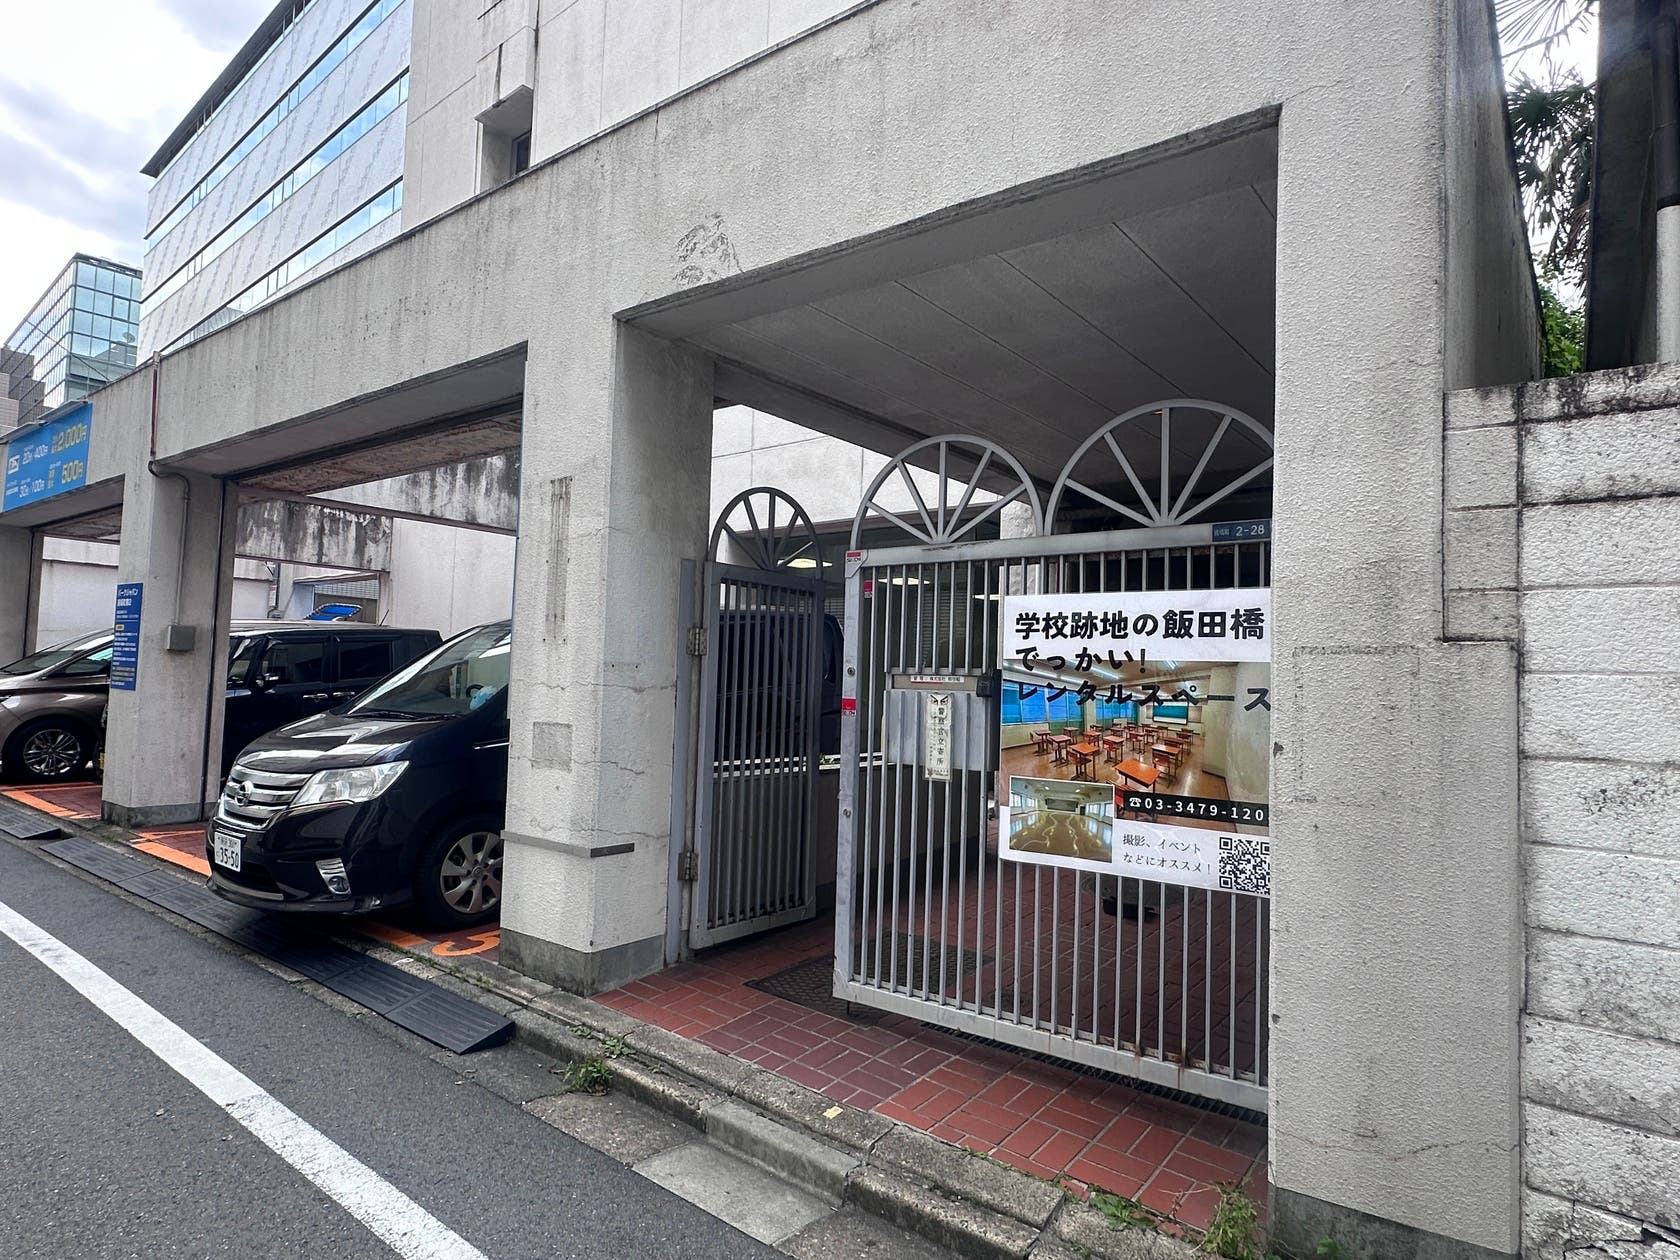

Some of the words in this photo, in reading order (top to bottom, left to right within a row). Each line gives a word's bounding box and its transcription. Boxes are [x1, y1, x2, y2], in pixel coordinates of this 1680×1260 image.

[1235, 524, 1265, 537] 2-28
[1015, 608, 1264, 640] 学校跡地の飯田橋
[1015, 646, 1147, 674] でっかい！
[1018, 680, 1271, 712] レンタルスペース
[1145, 798, 1270, 821] 03-3479-120
[1123, 833, 1201, 854] 撮影、イベント
[220, 847, 239, 869] 35-50
[1123, 852, 1212, 875] などにオススメ！
